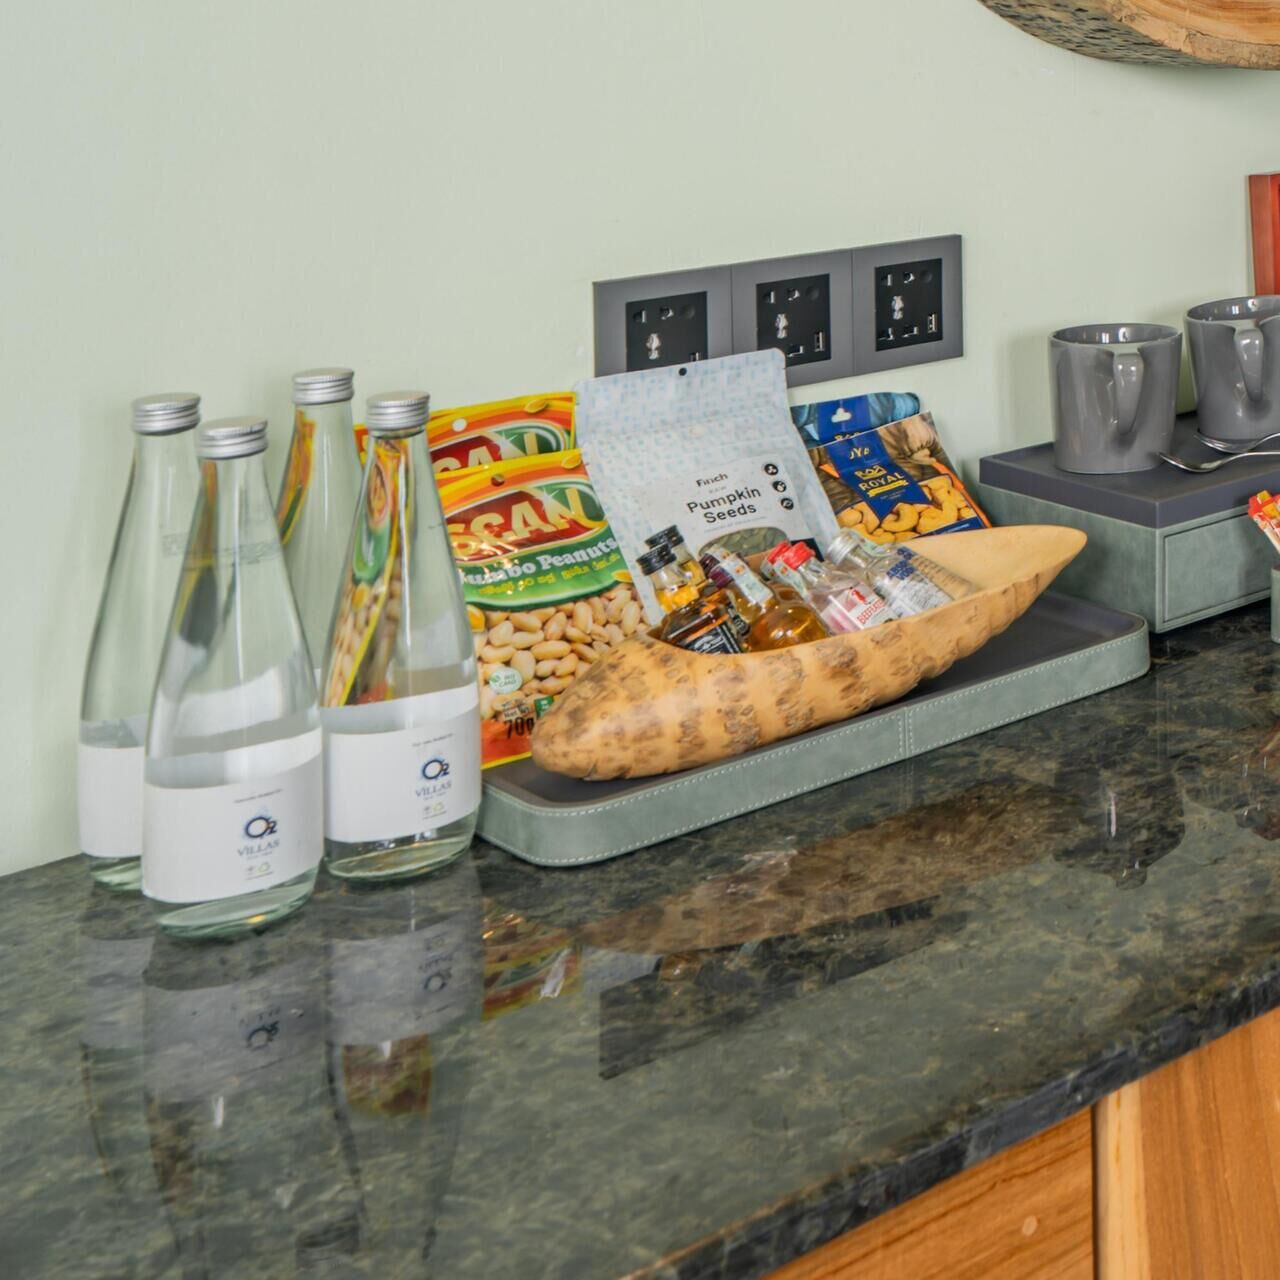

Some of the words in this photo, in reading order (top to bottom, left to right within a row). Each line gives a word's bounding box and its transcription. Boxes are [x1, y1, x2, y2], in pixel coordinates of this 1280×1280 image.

[695, 473, 729, 487] Finch
[858, 472, 905, 491] ROYAL
[686, 486, 761, 513] Pumpkin
[447, 486, 608, 561] SCAN
[703, 503, 757, 524] Seeds
[536, 537, 618, 570] Peanuts
[422, 759, 450, 781] O2
[415, 781, 452, 797] VILLAS
[245, 816, 278, 839] O2
[237, 839, 280, 856] VILLAS
